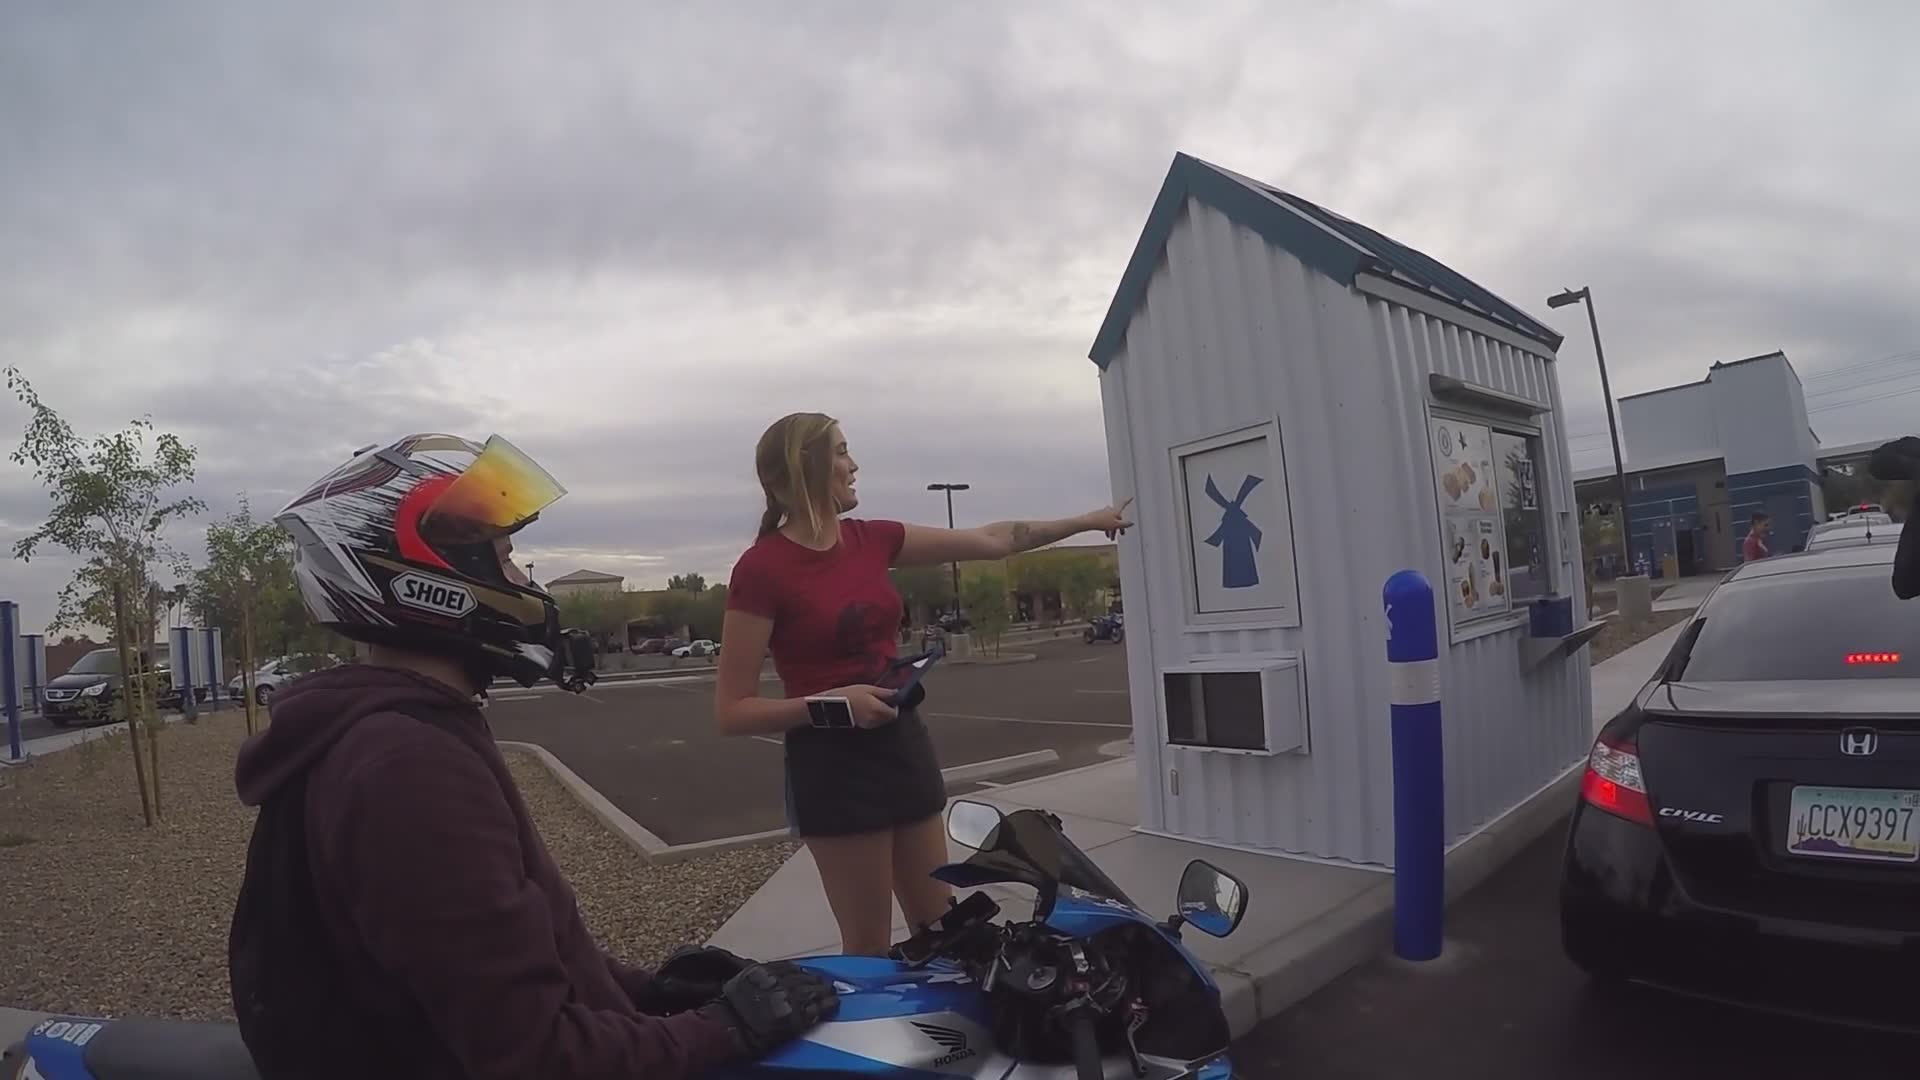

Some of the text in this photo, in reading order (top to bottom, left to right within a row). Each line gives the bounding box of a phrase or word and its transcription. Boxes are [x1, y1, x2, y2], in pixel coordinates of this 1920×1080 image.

[403, 579, 466, 611] SHOEI
[1659, 807, 1724, 823] CIVIC
[1808, 804, 1913, 842] CCX9397
[934, 1048, 977, 1068] HONDA
